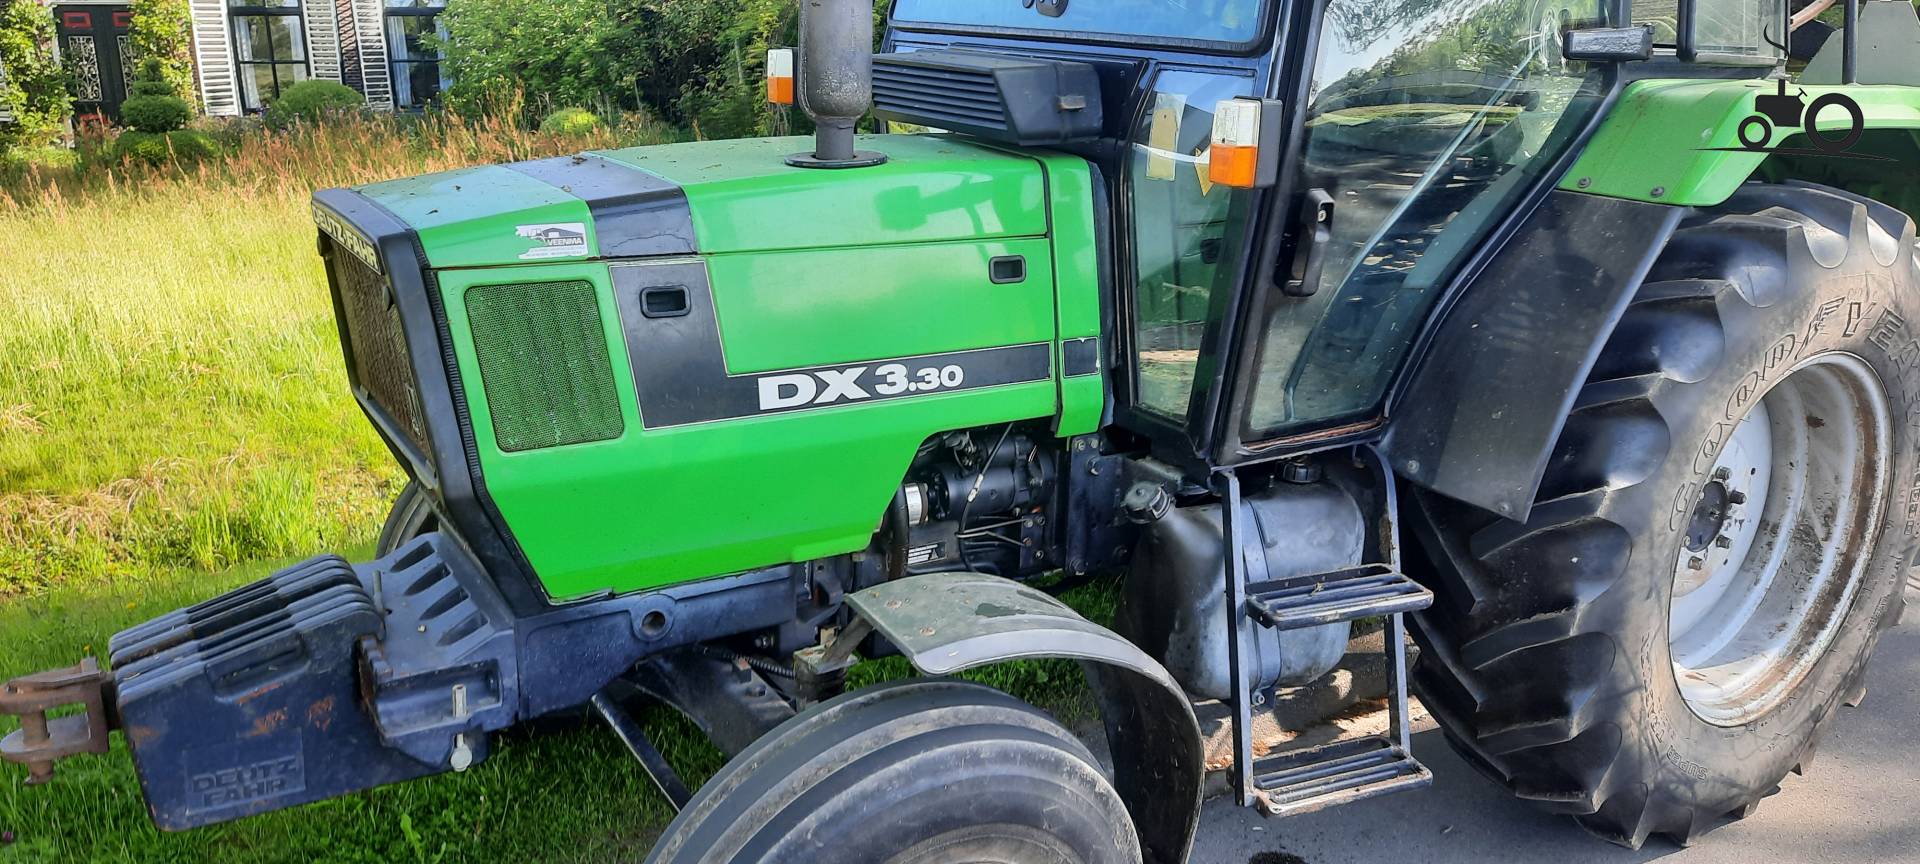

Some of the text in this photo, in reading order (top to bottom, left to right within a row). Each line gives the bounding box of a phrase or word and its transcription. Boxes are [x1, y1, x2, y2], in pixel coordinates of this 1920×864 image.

[546, 236, 583, 247] VEENMA
[757, 363, 965, 411] DX 3.30
[191, 756, 299, 794] DEUTZ
[202, 776, 288, 807] FAHR
